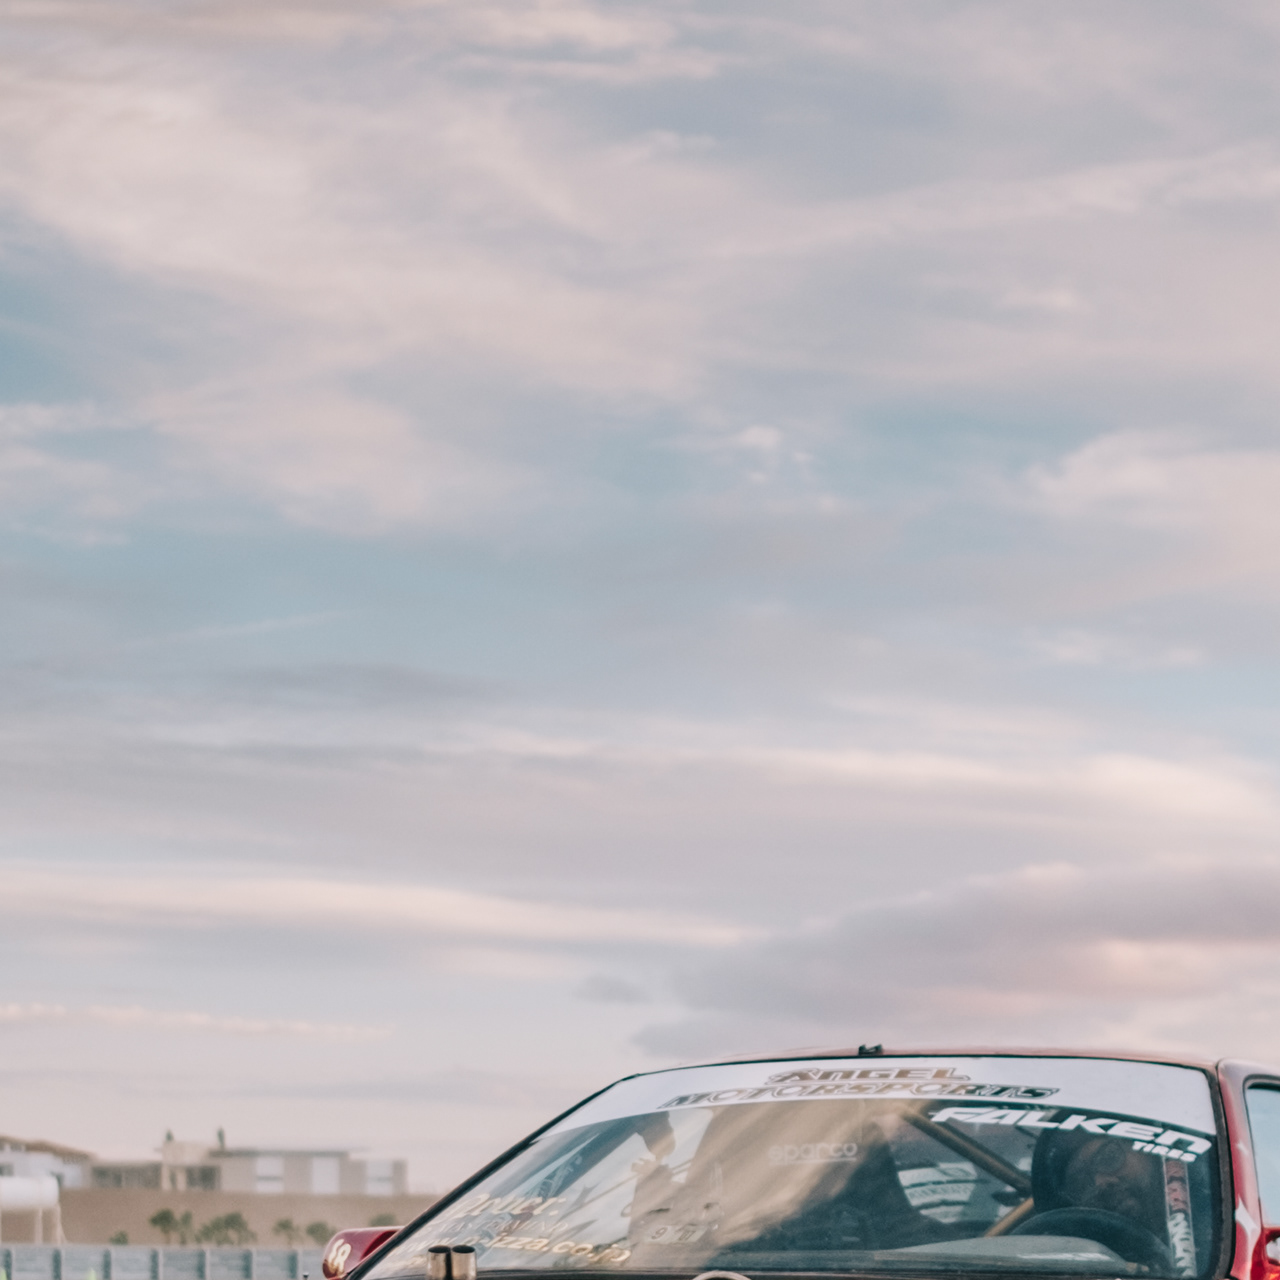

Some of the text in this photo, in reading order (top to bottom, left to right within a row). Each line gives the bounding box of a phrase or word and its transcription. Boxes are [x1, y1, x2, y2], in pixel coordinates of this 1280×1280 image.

[660, 1083, 1060, 1108] MOTORSPORTS
[929, 1106, 1212, 1155] FALKEN
[767, 1142, 858, 1161] sparco
[1131, 1140, 1197, 1164] TIRES
